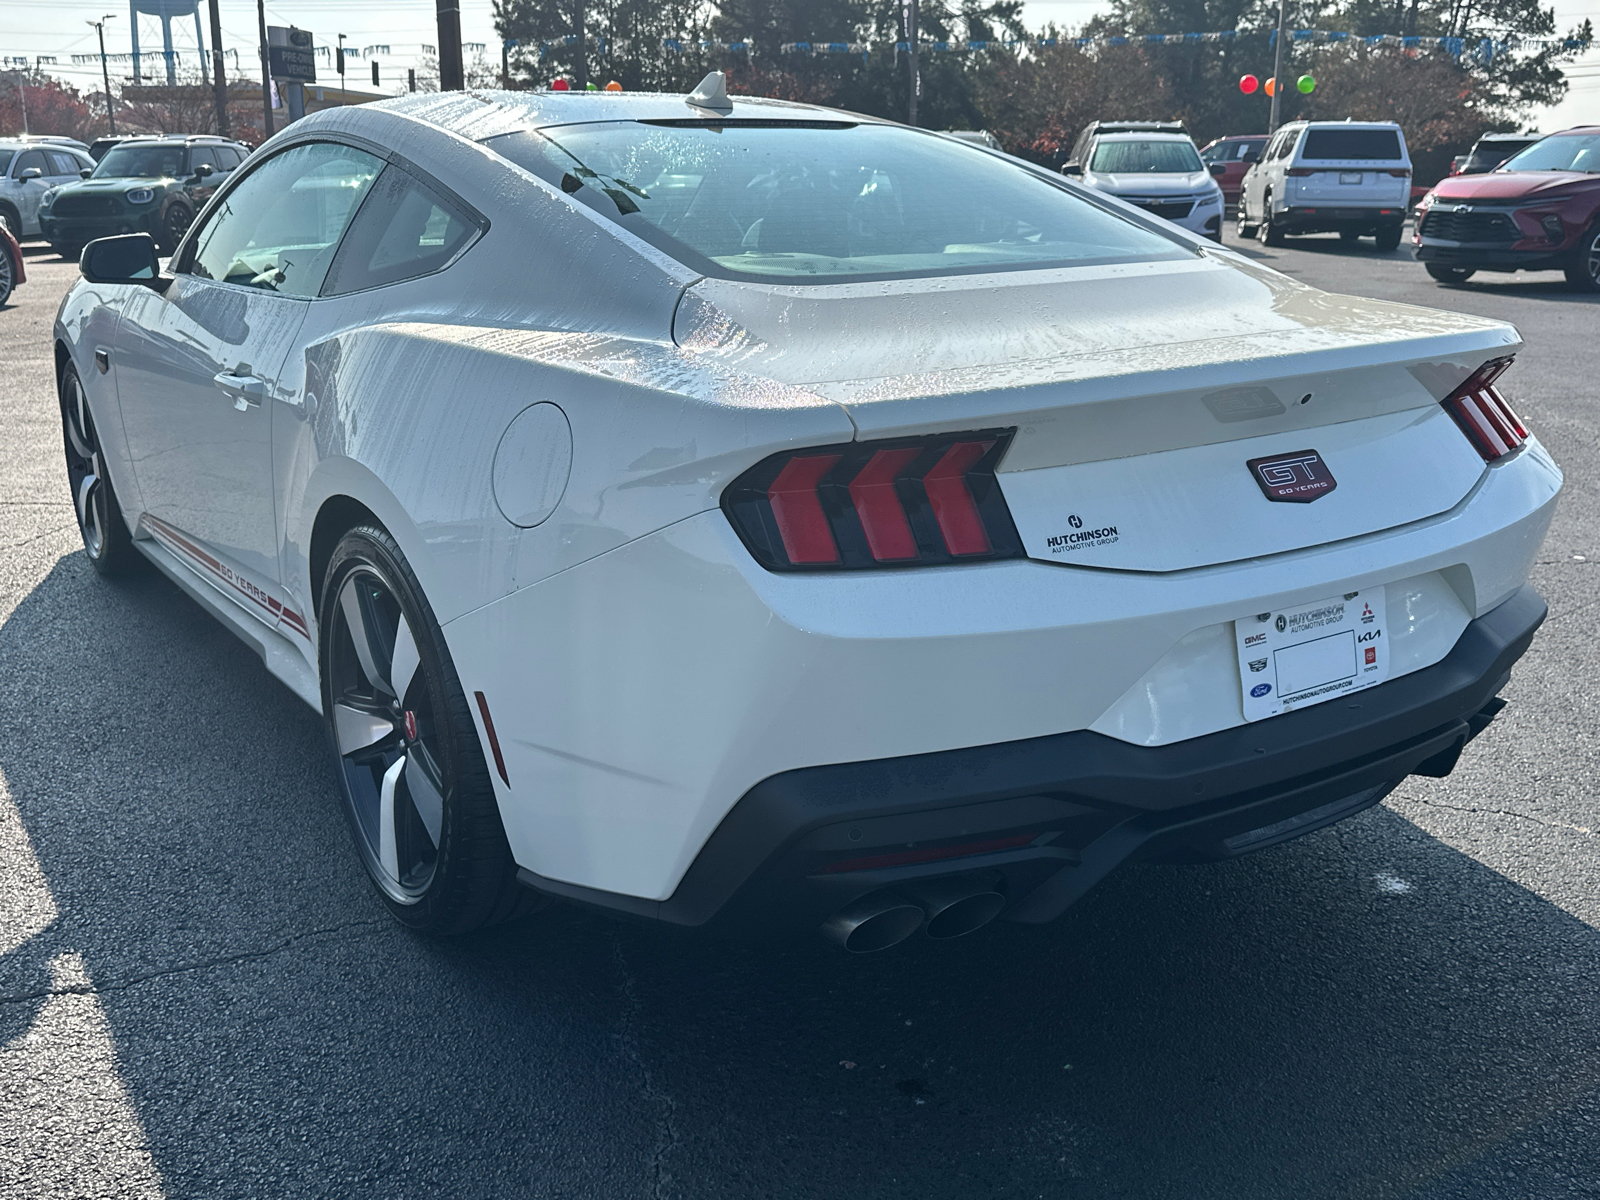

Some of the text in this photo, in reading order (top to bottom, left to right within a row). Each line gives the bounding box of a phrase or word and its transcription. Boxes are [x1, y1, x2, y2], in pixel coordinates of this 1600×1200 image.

[282, 51, 313, 64] PRE-OWNE
[287, 64, 314, 76] VEHICLE
[1257, 455, 1318, 487] GT
[1278, 481, 1328, 496] 60 YEARS
[1046, 526, 1118, 548] HUTCHINSON
[1051, 536, 1119, 554] AUTOMOTIVE GROUP
[220, 564, 267, 603] 60 YEARS
[1288, 603, 1345, 627] HUTCHINSON
[1290, 614, 1344, 634] AUTOMOTIVE GROUP
[1244, 632, 1267, 645] GMC
[1282, 679, 1353, 705] HUTCHINSONAUTOGROUP.COM
